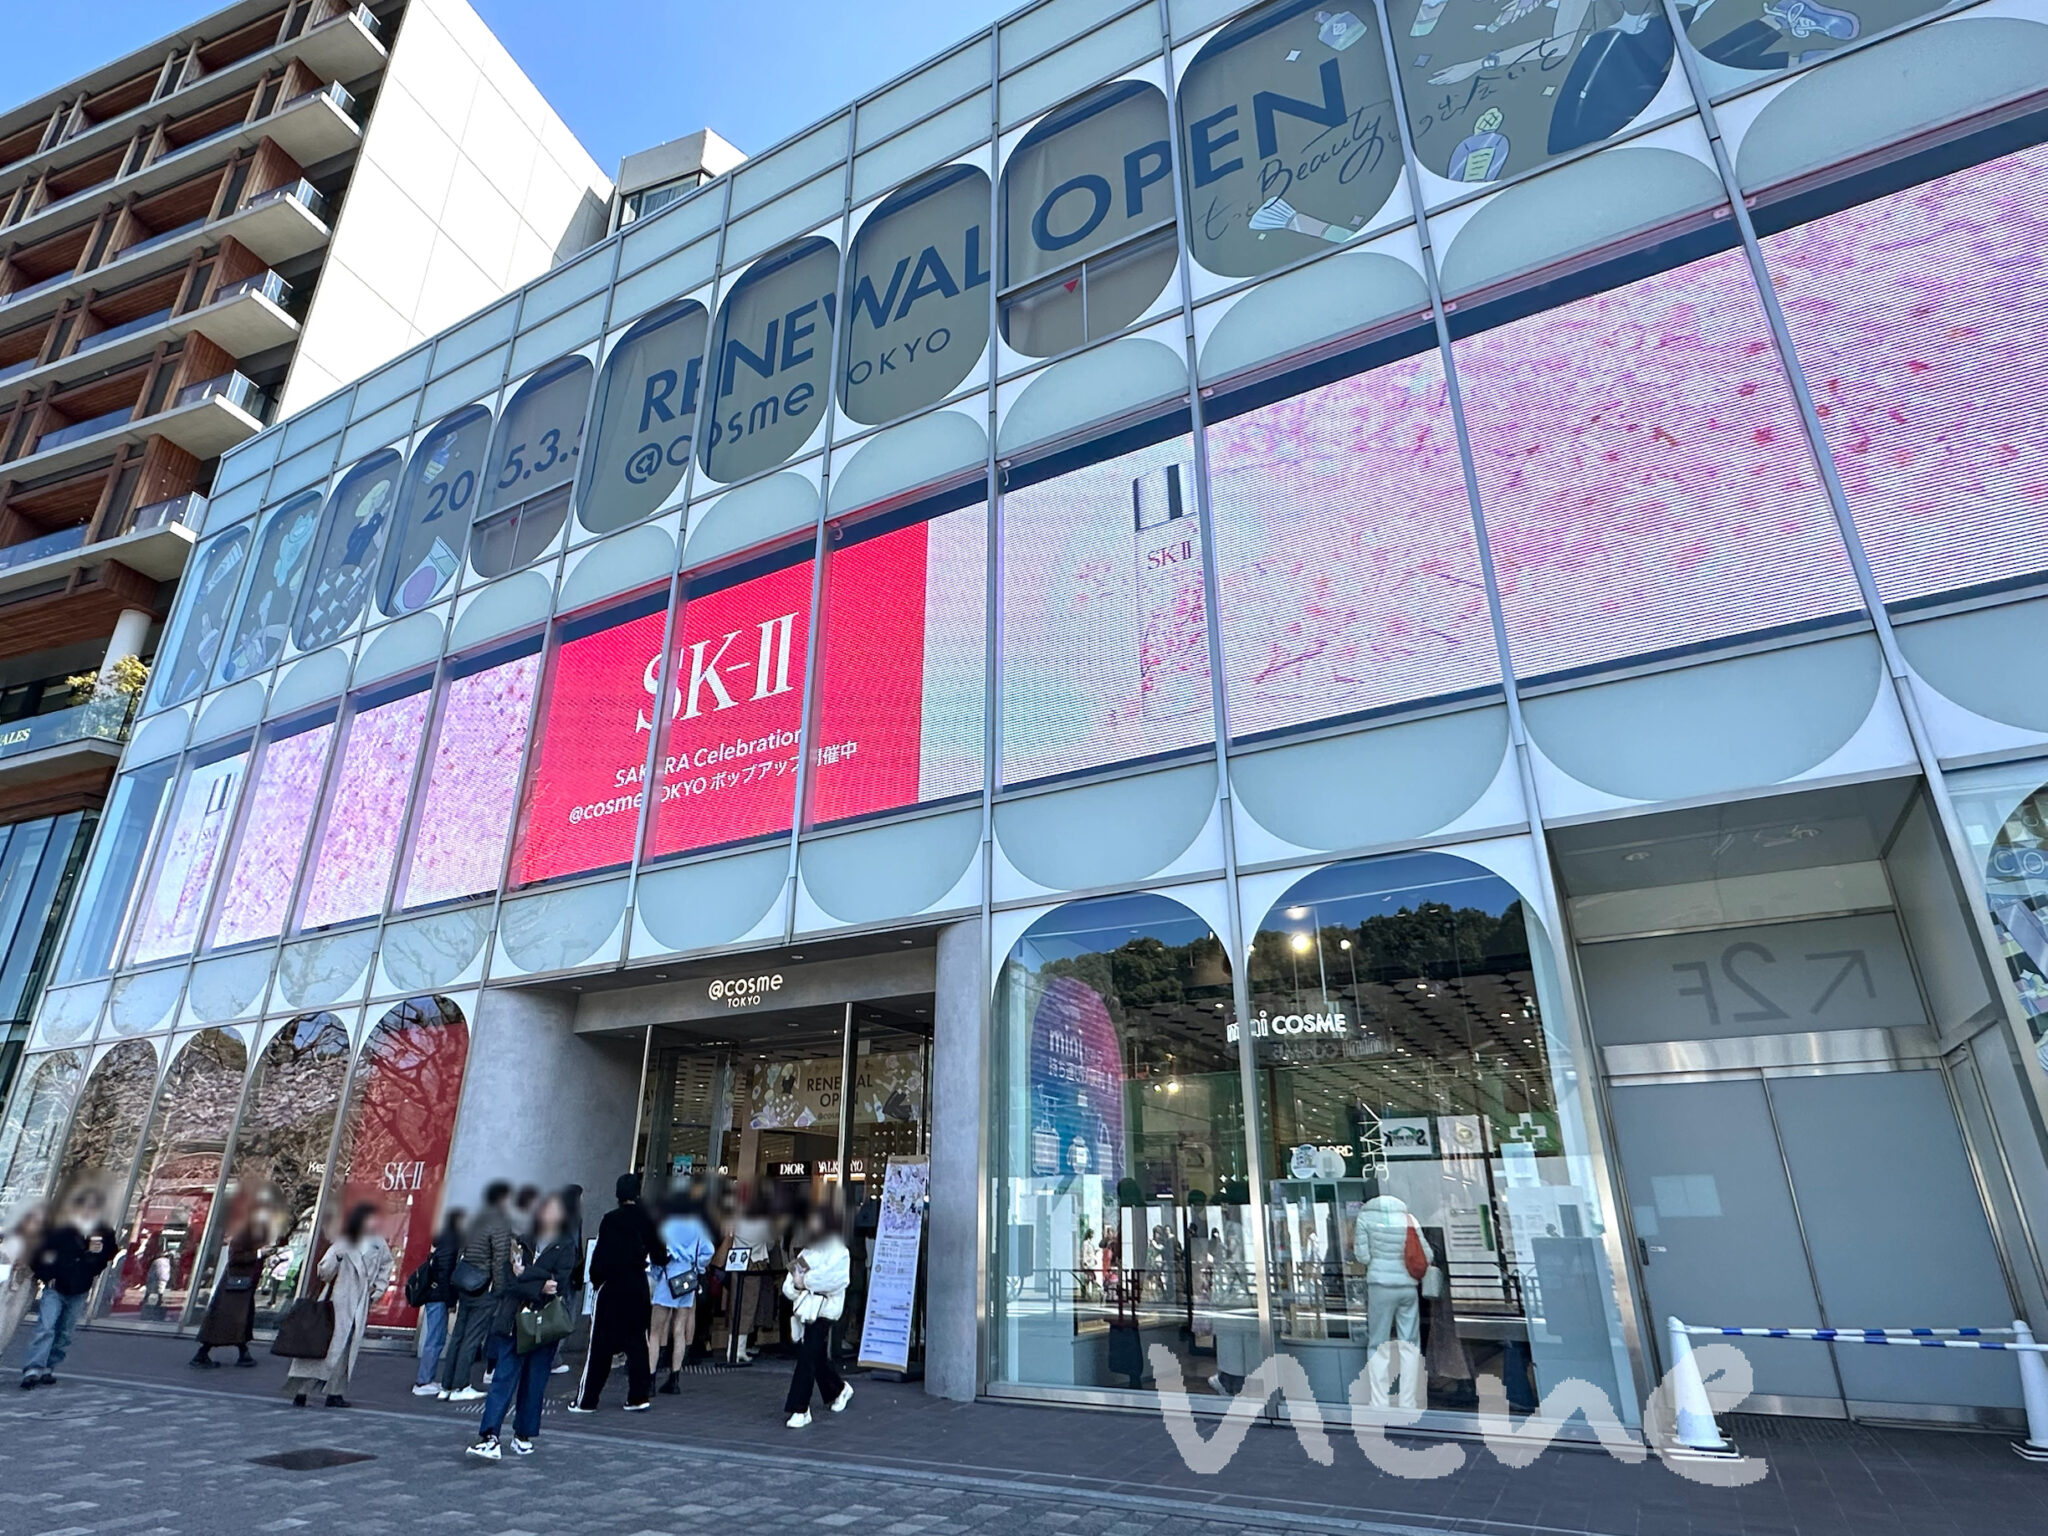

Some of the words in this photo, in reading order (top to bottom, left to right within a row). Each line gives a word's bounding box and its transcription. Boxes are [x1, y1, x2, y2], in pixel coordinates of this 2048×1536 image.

[1257, 99, 1392, 209] Beauty
[638, 224, 991, 434] RENEWAL
[1031, 57, 1348, 251] OPEN
[849, 328, 951, 385] OKYO
[635, 612, 798, 734] SK-II
[614, 753, 690, 788] SAKRA
[694, 729, 802, 768] Celebration
[569, 793, 644, 824] @cosme
[660, 777, 707, 803] OKYO
[709, 741, 858, 790] ポップアップ催中
[708, 973, 784, 1000] @cosme
[727, 995, 761, 1008] TOKYO
[1227, 1010, 1269, 1042] mni
[1271, 1013, 1347, 1034] COSME
[807, 1074, 873, 1092] RENEAL
[820, 1091, 859, 1107] OP
[381, 1161, 425, 1191] SK-II
[779, 1163, 805, 1176] DIOR
